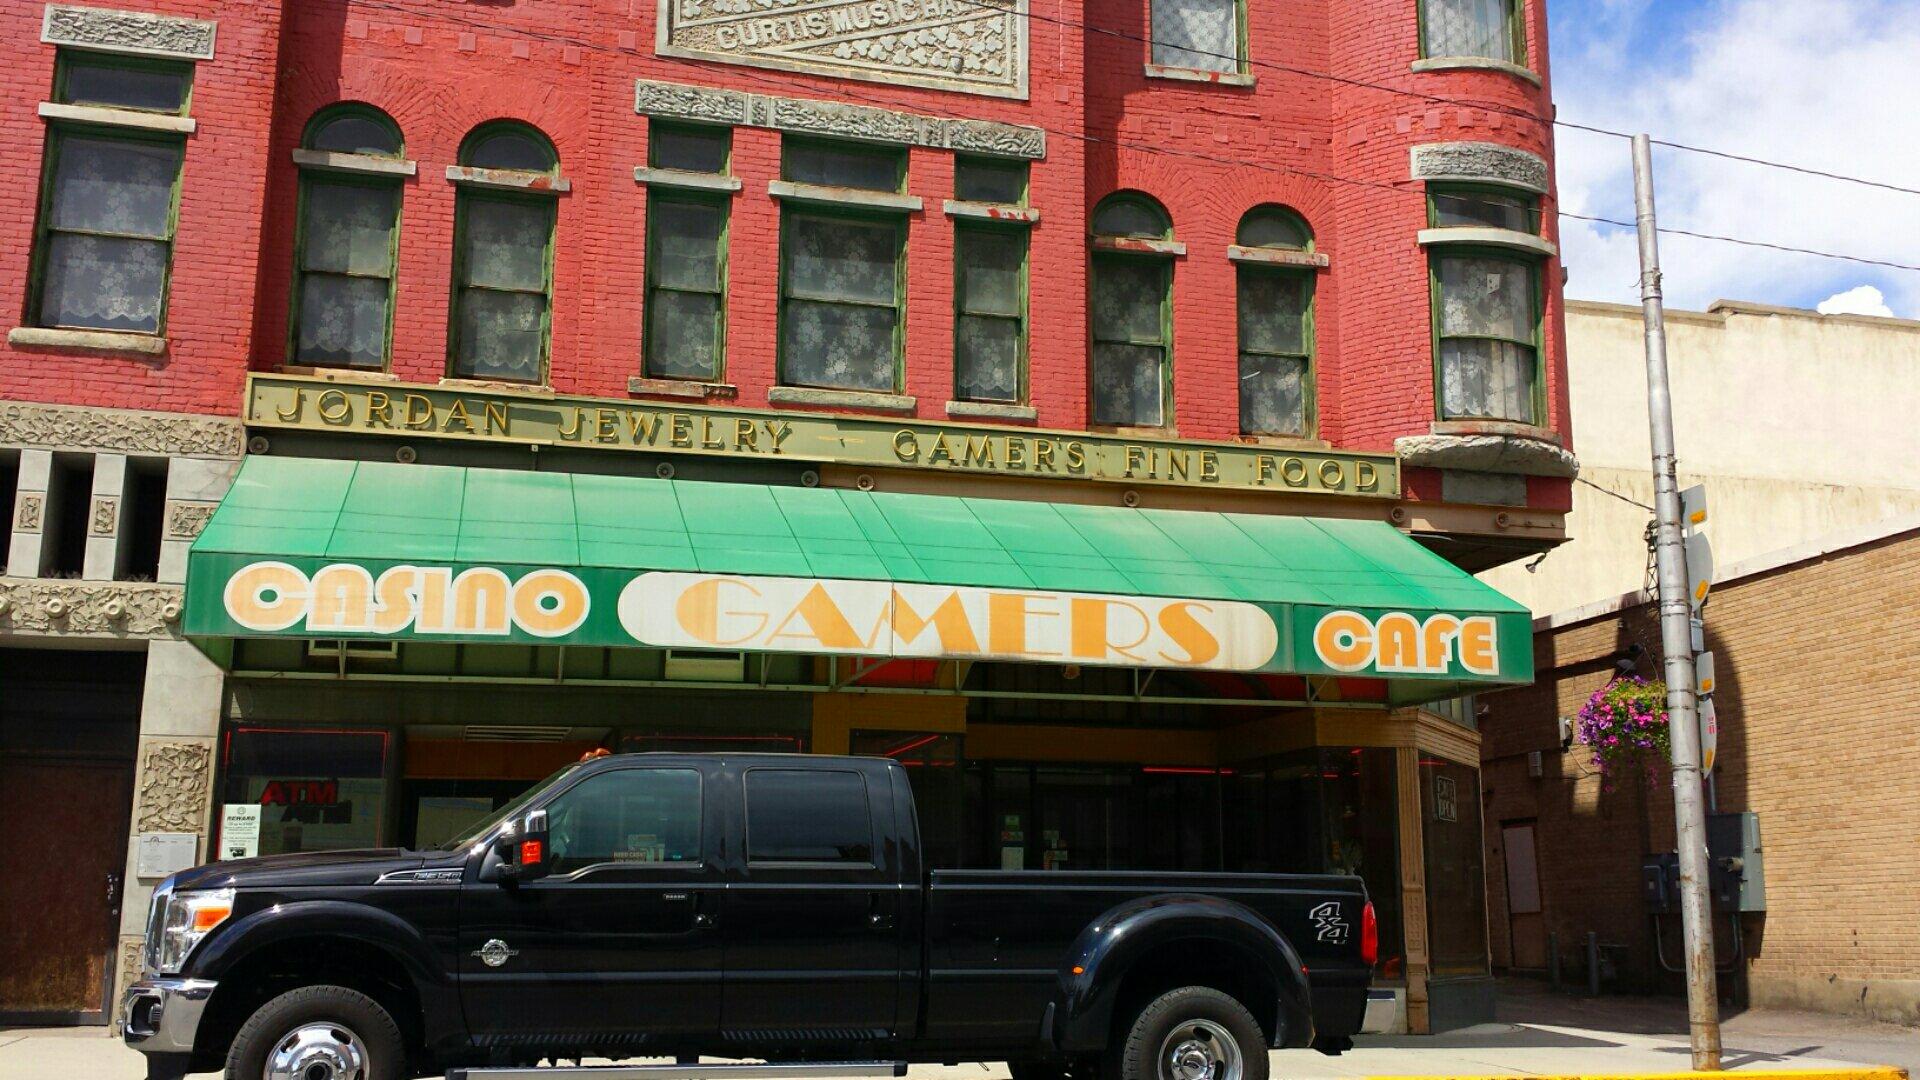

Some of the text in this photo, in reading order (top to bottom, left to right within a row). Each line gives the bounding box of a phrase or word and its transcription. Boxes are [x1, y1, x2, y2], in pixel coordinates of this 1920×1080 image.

[715, 12, 827, 49] CURTIS
[831, 0, 918, 33] MUSIC
[277, 387, 1379, 490] JORDAN JEWELRY GAMER'S FINE FOOD
[223, 560, 1499, 676] CASINO GAMERS CAFE
[260, 780, 338, 806] ATM
